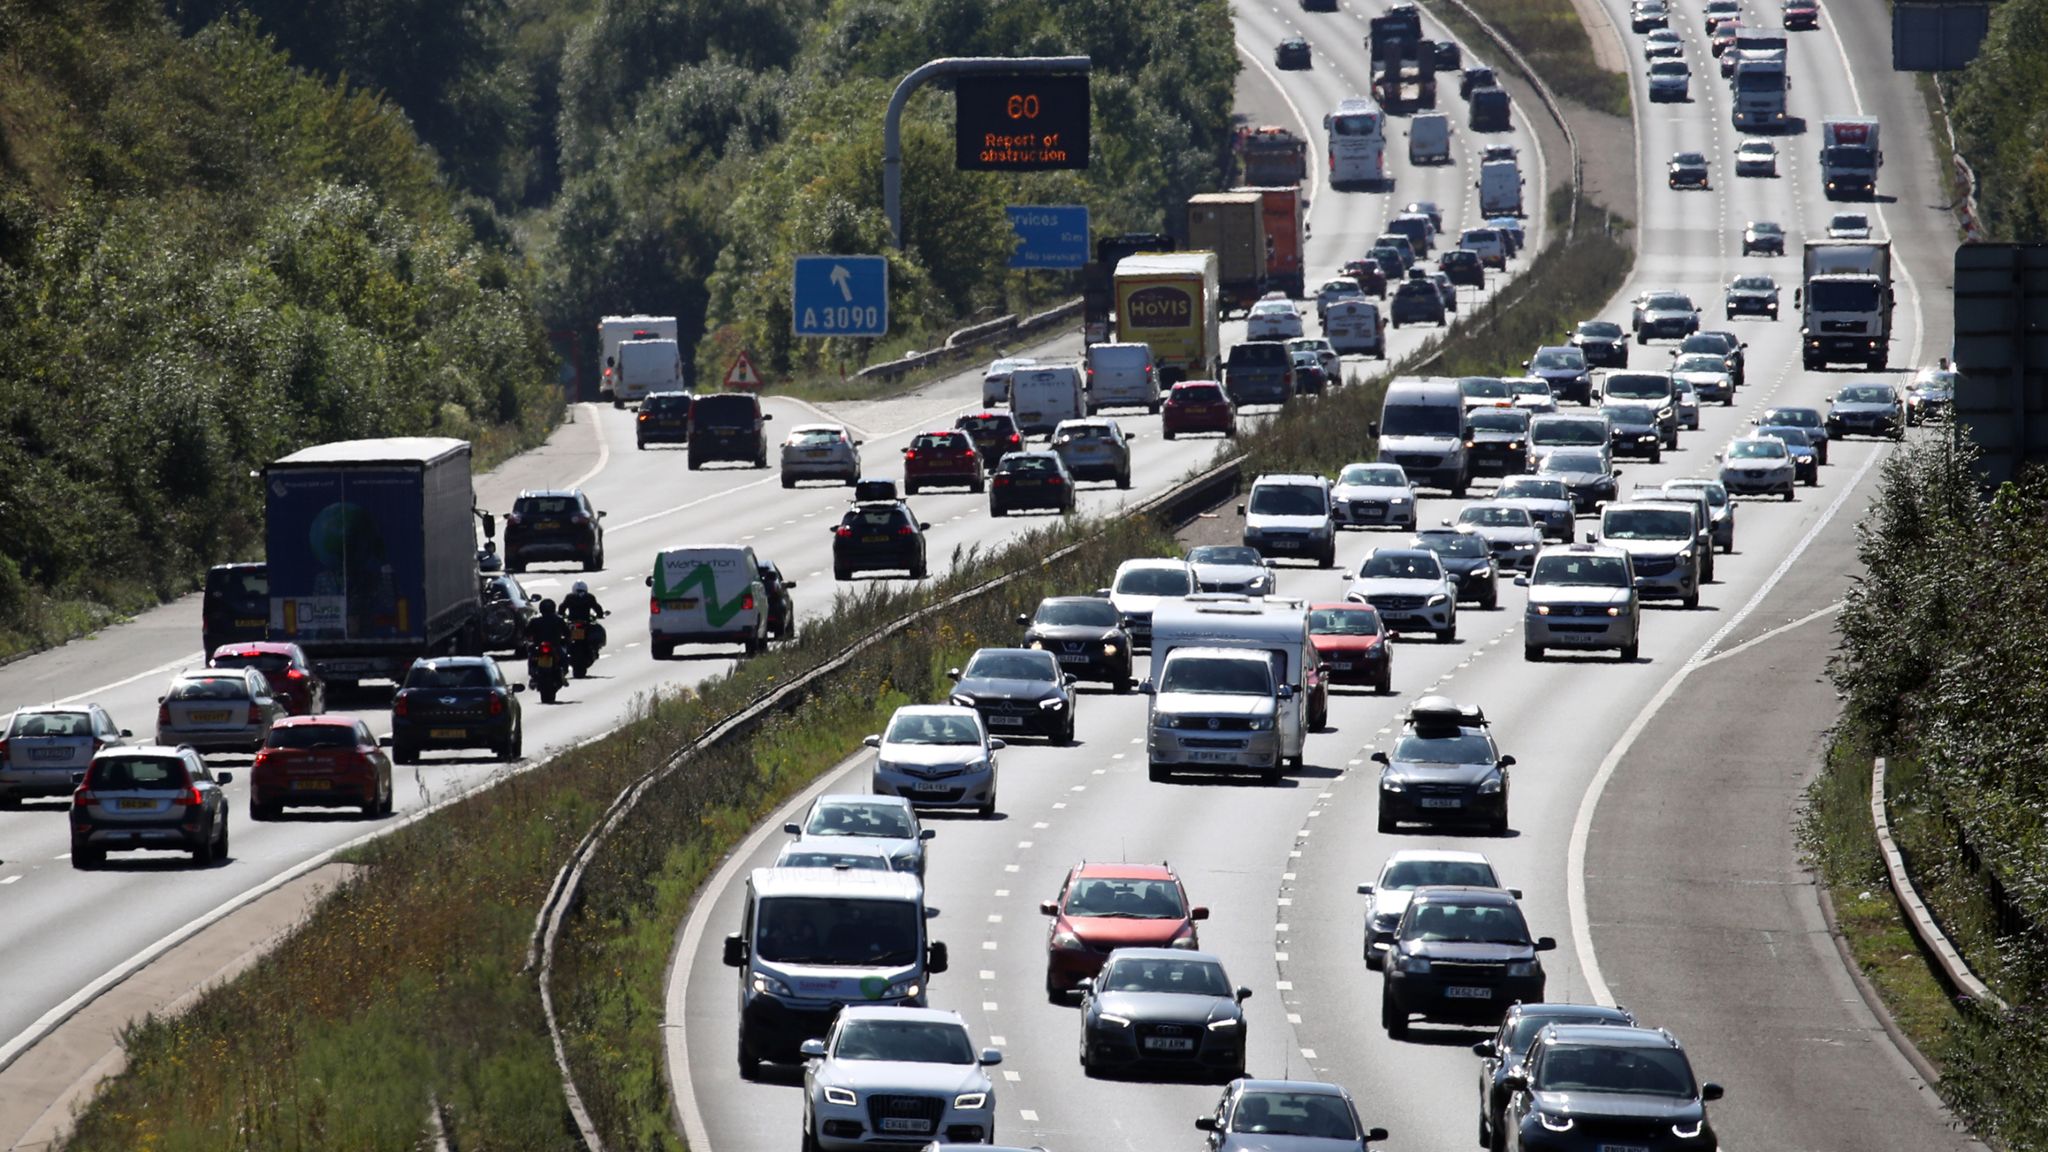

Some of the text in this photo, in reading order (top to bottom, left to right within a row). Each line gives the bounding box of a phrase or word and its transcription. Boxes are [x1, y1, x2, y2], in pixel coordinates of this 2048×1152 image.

[1007, 95, 1039, 119] 60
[985, 133, 1059, 148] Report of
[981, 149, 1067, 161] obstruction
[1131, 300, 1188, 316] HOVIS
[803, 306, 877, 329] A 3090
